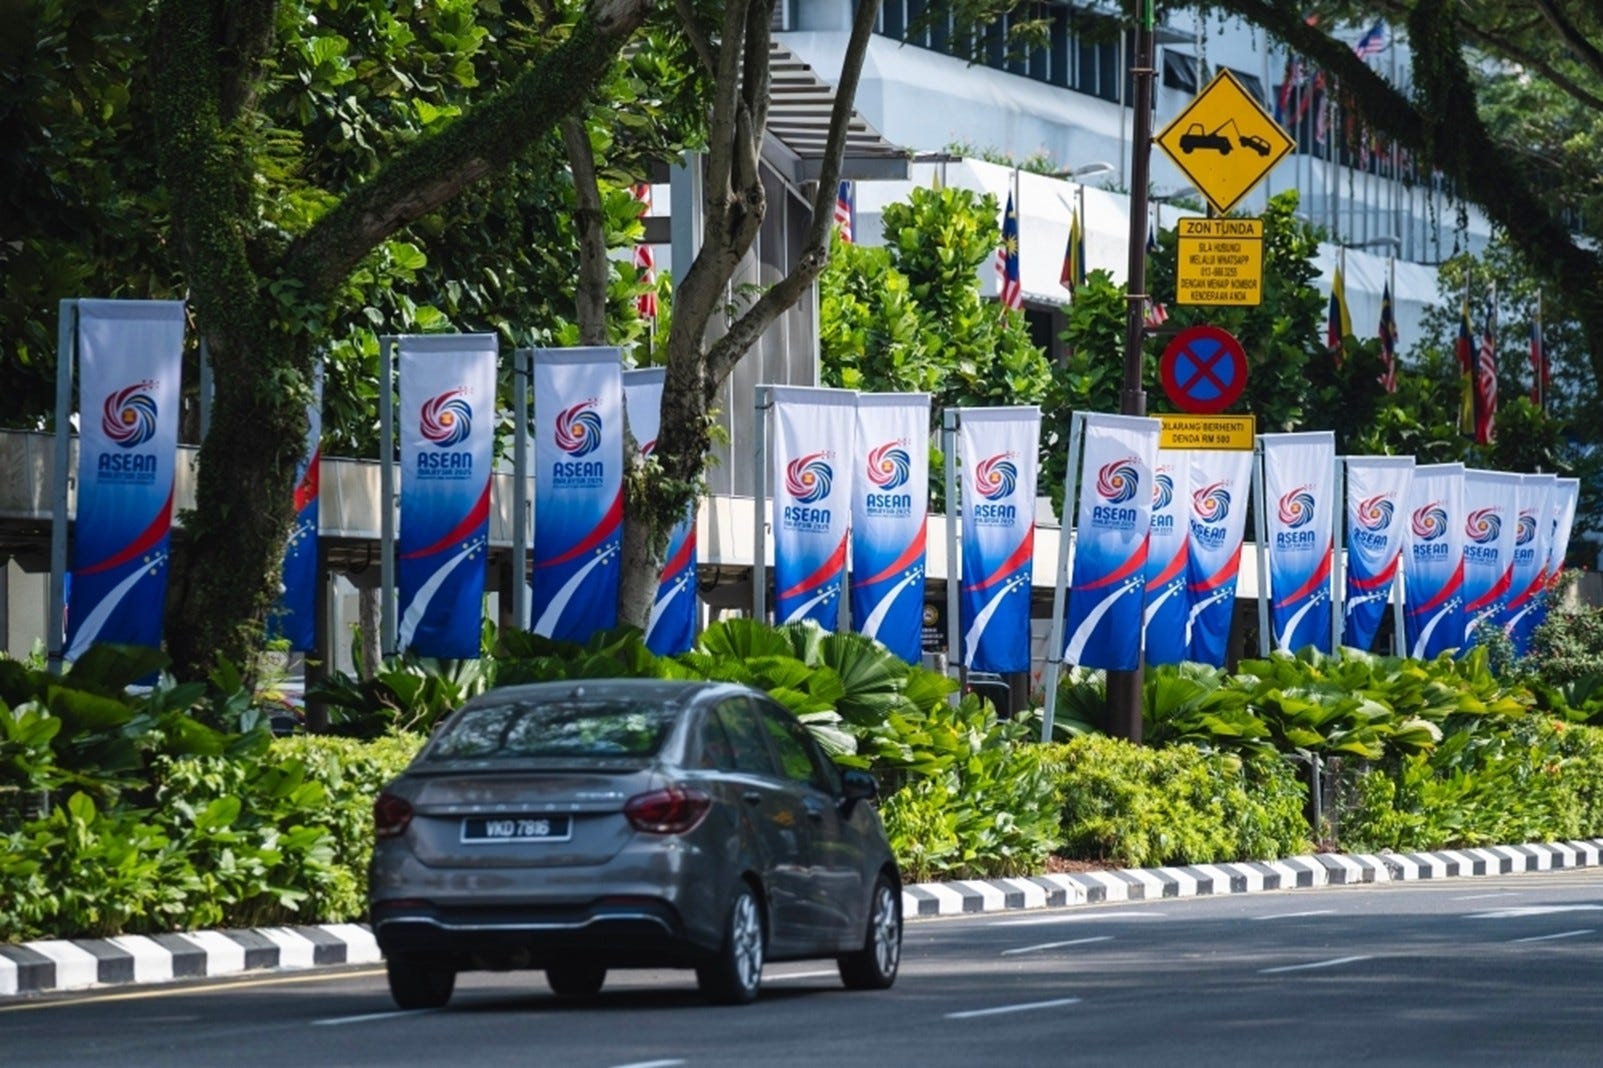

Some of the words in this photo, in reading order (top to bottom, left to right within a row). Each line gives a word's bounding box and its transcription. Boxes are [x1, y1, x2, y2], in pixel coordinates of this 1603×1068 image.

[1187, 222, 1211, 234] ZON
[1215, 222, 1255, 235] TUNDA
[1217, 255, 1249, 265] WHATSAPP
[1230, 291, 1247, 300] ANDA
[1203, 423, 1244, 431] BERHENTI
[1173, 434, 1199, 443] DENDA
[1202, 435, 1216, 443] RM
[98, 453, 157, 472] ASEAN
[417, 452, 472, 468] ASEAN
[553, 462, 603, 477] ASEAN
[867, 493, 911, 508] ASEAN
[784, 506, 831, 523] ASEAN
[974, 504, 1016, 519] ASEAN
[1092, 506, 1137, 522] ASEAN
[1150, 514, 1173, 527] EAN
[1191, 520, 1227, 540] ASEAN
[1353, 527, 1387, 546] ASEAN
[1277, 531, 1315, 544] ASEAN
[1413, 543, 1448, 555] ASEAN
[1463, 545, 1498, 559] ASEAN
[1514, 548, 1534, 559] EAN
